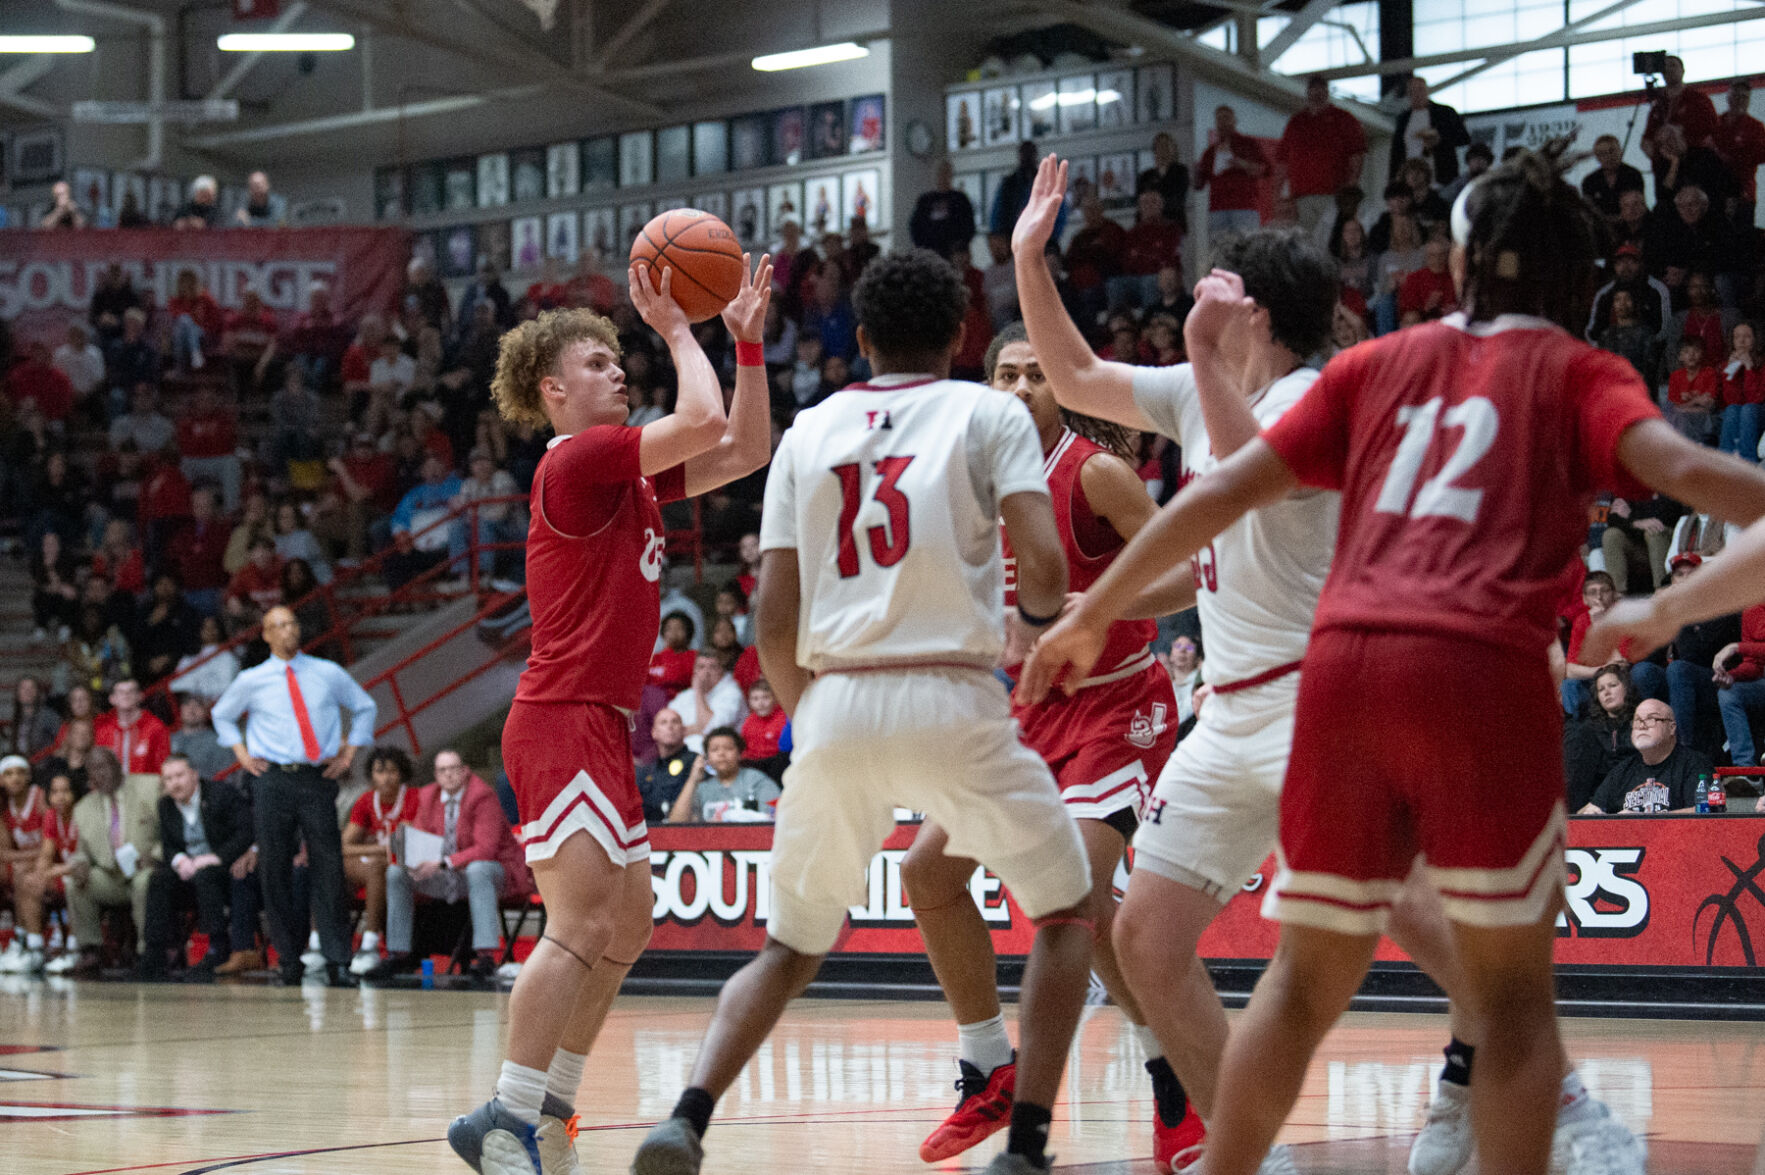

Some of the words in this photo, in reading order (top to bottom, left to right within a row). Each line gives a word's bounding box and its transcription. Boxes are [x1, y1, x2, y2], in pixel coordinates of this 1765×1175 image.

[0, 256, 338, 318] SOUHRIDGE
[830, 455, 916, 580] 13
[1374, 395, 1499, 523] 12
